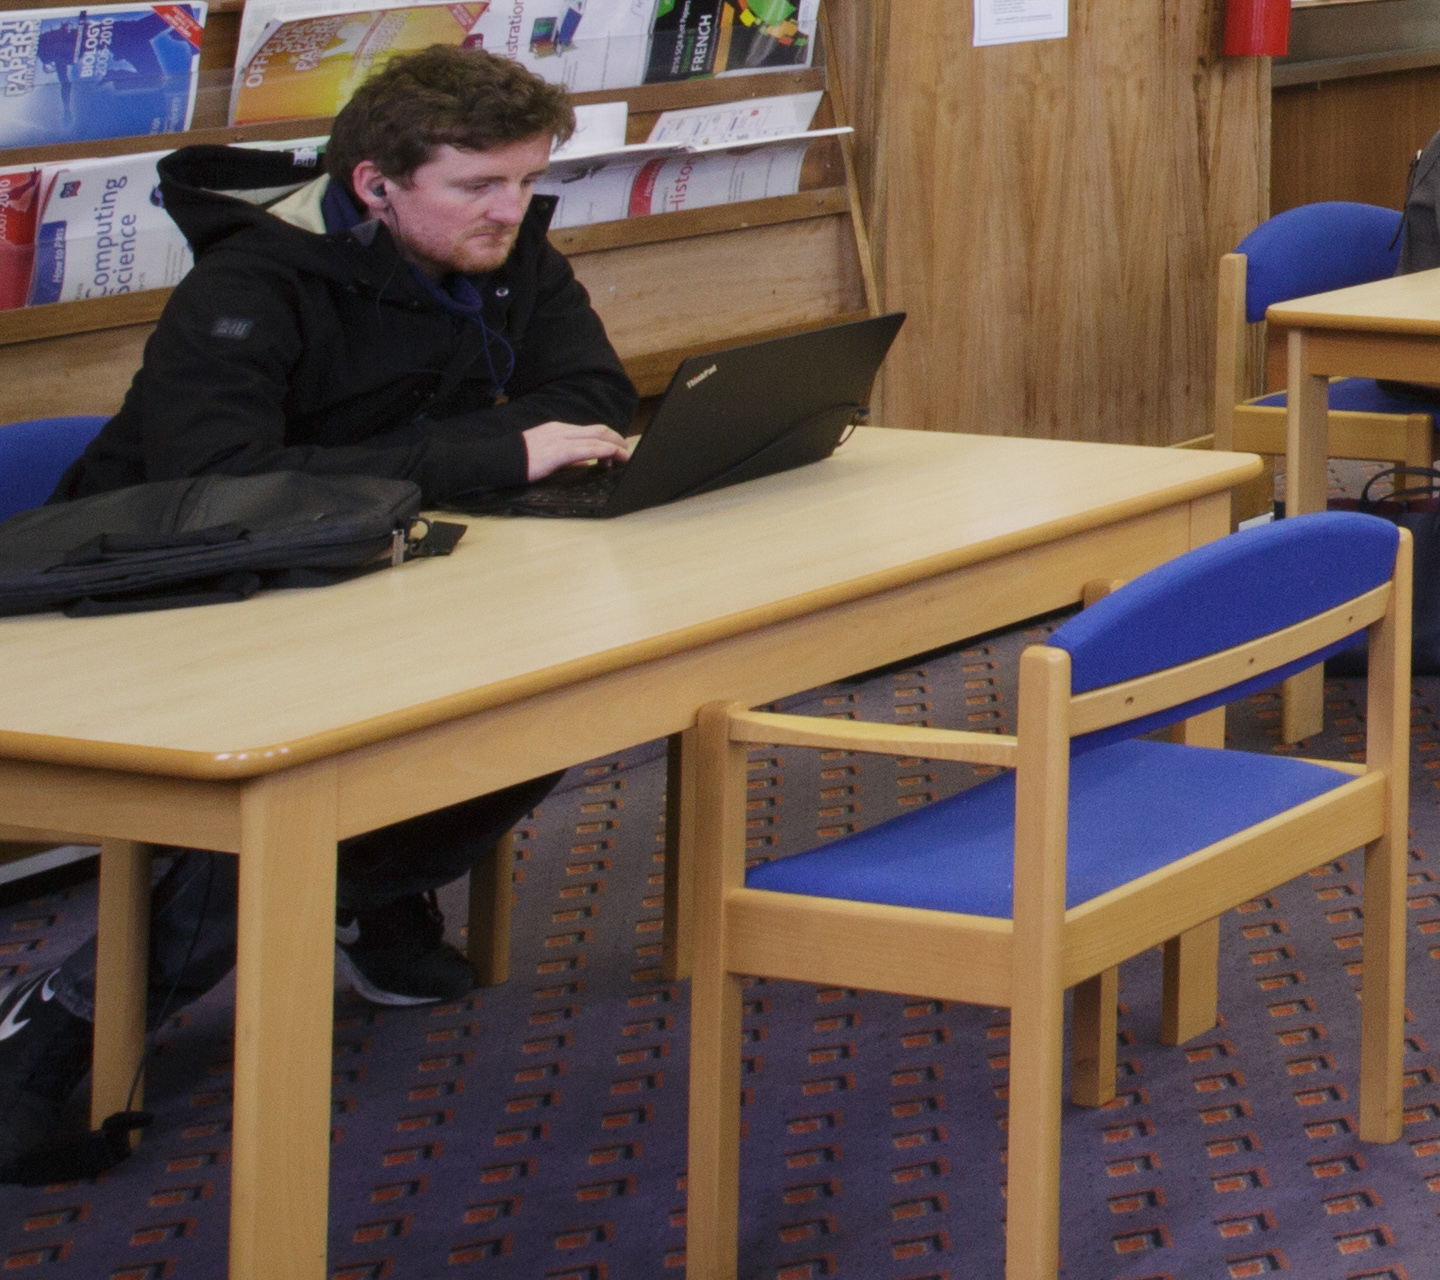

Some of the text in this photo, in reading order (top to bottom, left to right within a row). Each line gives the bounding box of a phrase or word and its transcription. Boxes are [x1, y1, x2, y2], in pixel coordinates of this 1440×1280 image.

[6, 20, 33, 96] PAPERS
[81, 19, 100, 78] BIOLOGY
[690, 14, 713, 72] FRENCH
[52, 227, 65, 283] How to Pass
[86, 176, 128, 298] Computing
[110, 214, 137, 295] Science
